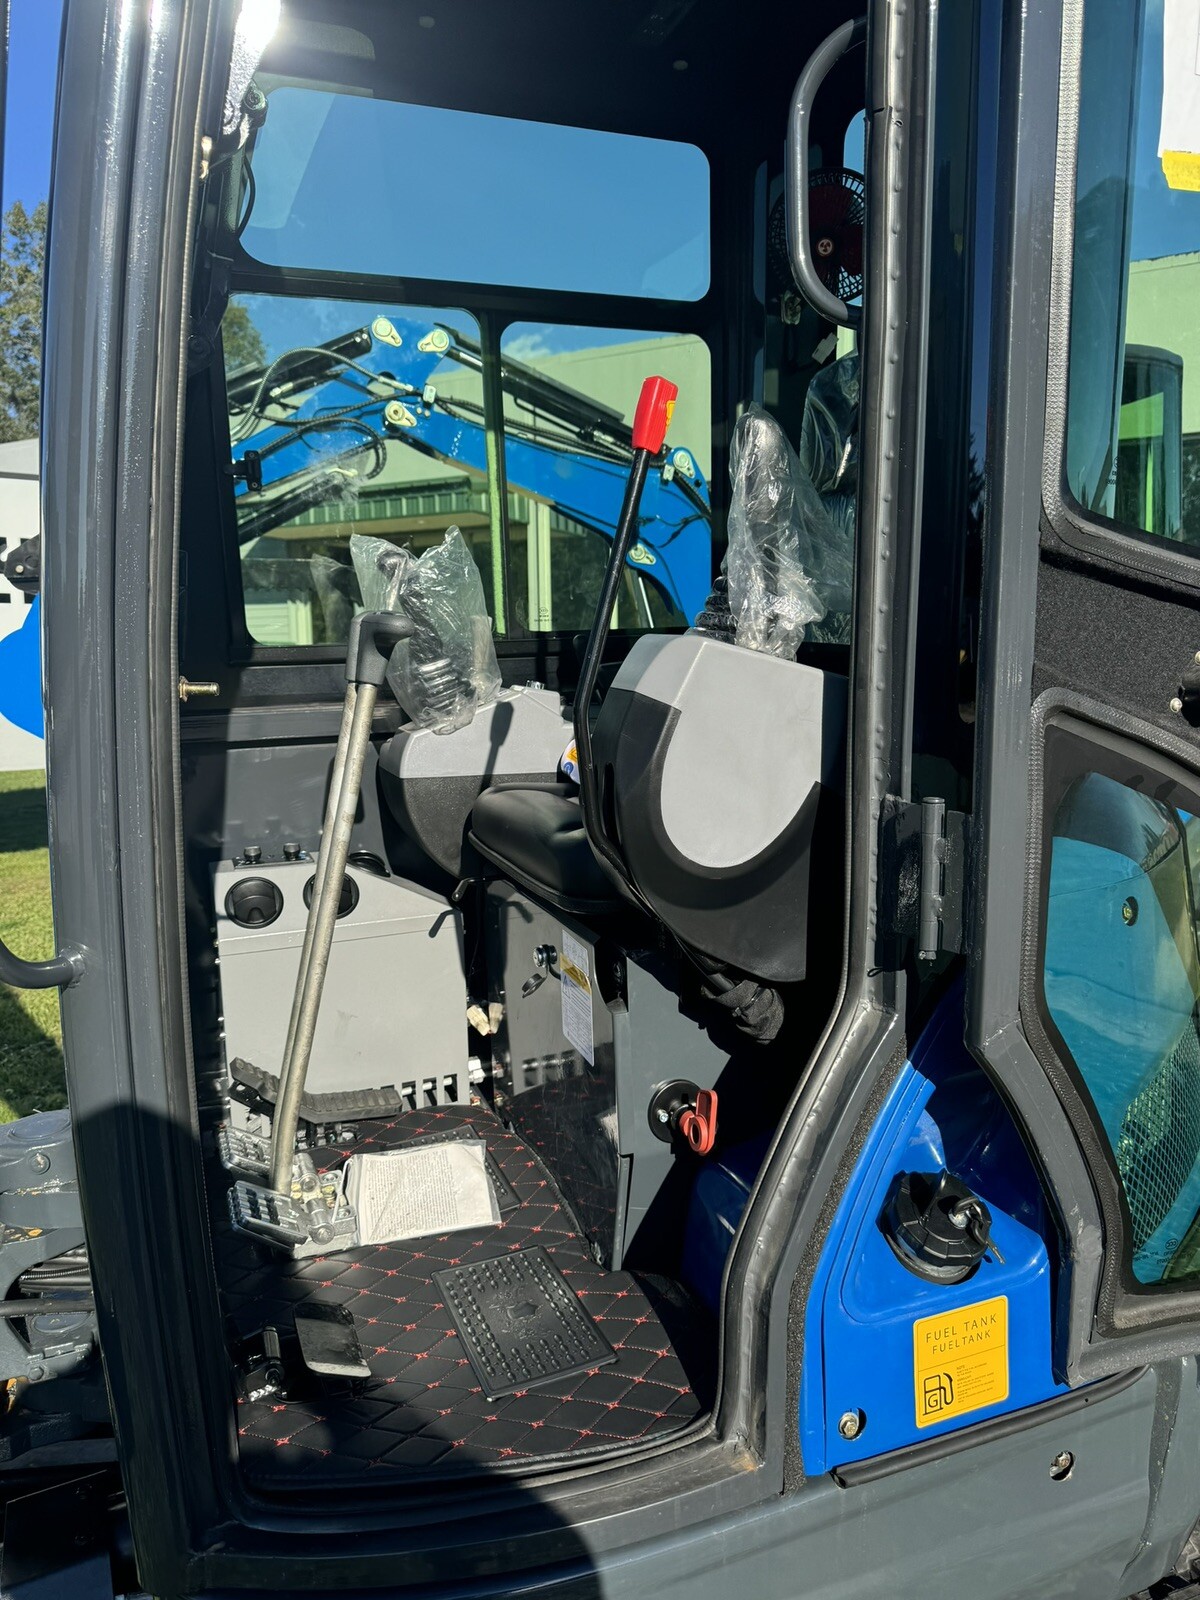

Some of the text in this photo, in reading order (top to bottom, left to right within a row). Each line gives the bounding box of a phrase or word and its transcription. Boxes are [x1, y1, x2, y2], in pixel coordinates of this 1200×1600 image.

[926, 1313, 997, 1343] FUEL TANK
[927, 1394, 938, 1408] G
